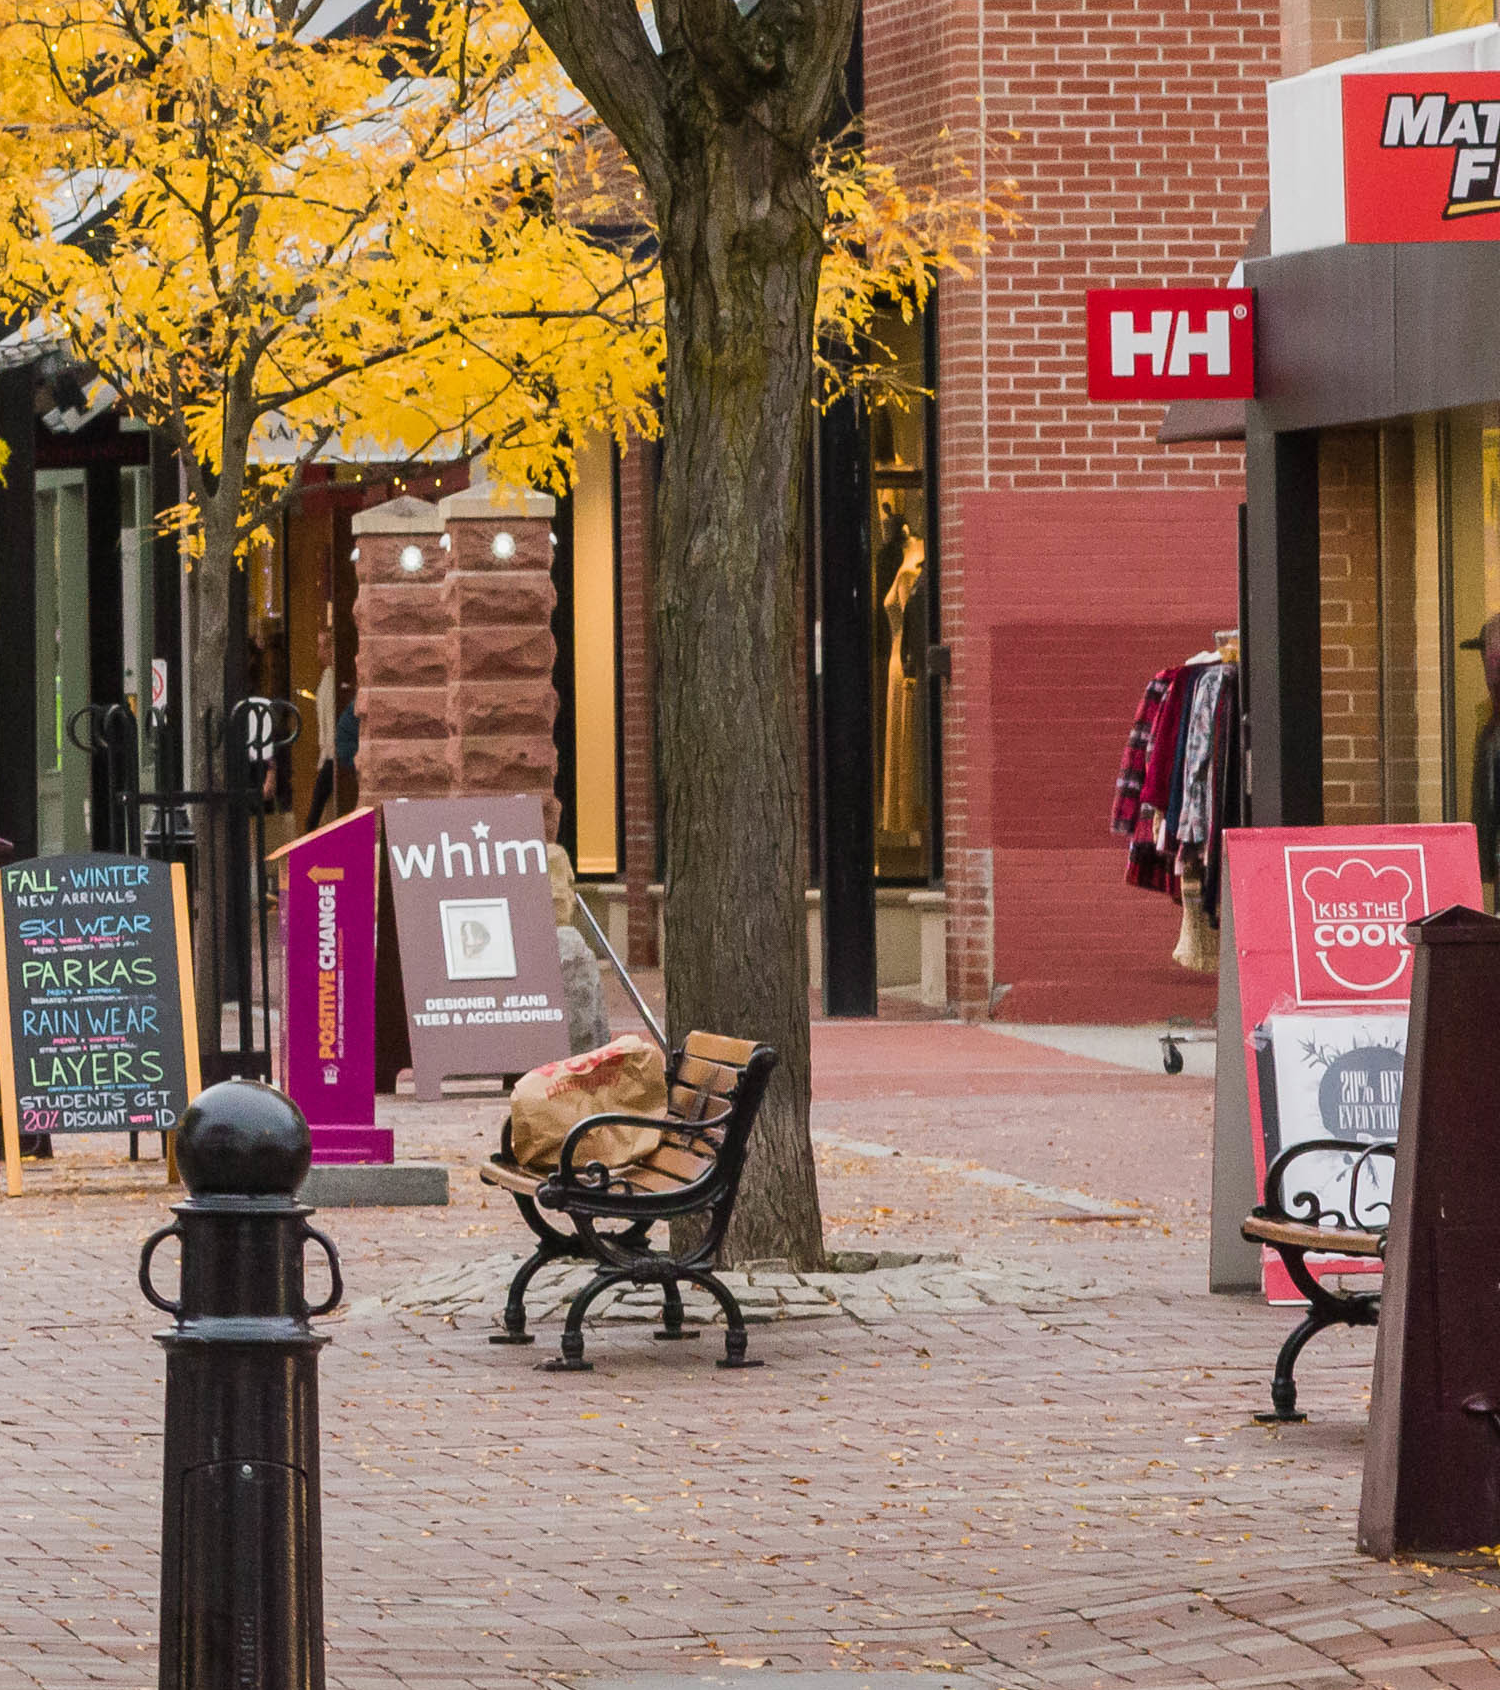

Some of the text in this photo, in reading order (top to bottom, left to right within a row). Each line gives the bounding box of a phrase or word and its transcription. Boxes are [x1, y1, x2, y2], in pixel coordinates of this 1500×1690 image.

[1380, 92, 1500, 149] MAT
[1449, 147, 1500, 200] F
[1109, 310, 1232, 378] HH
[391, 821, 548, 879] whim
[7, 865, 150, 893] FALL WINTER
[17, 890, 138, 908] NEW ARRIVALS
[1319, 901, 1399, 918] KISS THE
[19, 914, 153, 939] SKI WEAR
[318, 884, 336, 971] CHANGE
[1314, 924, 1409, 947] COOK
[22, 957, 157, 989] PARKAS
[318, 970, 336, 1060] POSITIVE
[414, 1009, 564, 1027] TEES & ACCESSORIES
[425, 994, 548, 1012] DESIGNER JEANS
[23, 1005, 160, 1037] RAIN WEAR
[30, 1050, 164, 1087] LAYERS
[19, 1091, 171, 1110] STUDENTS GET
[1339, 1070, 1404, 1104] 20% OF
[23, 1110, 60, 1132] 20%
[155, 1109, 177, 1127] ID
[1338, 1104, 1401, 1130] EVERYTHI
